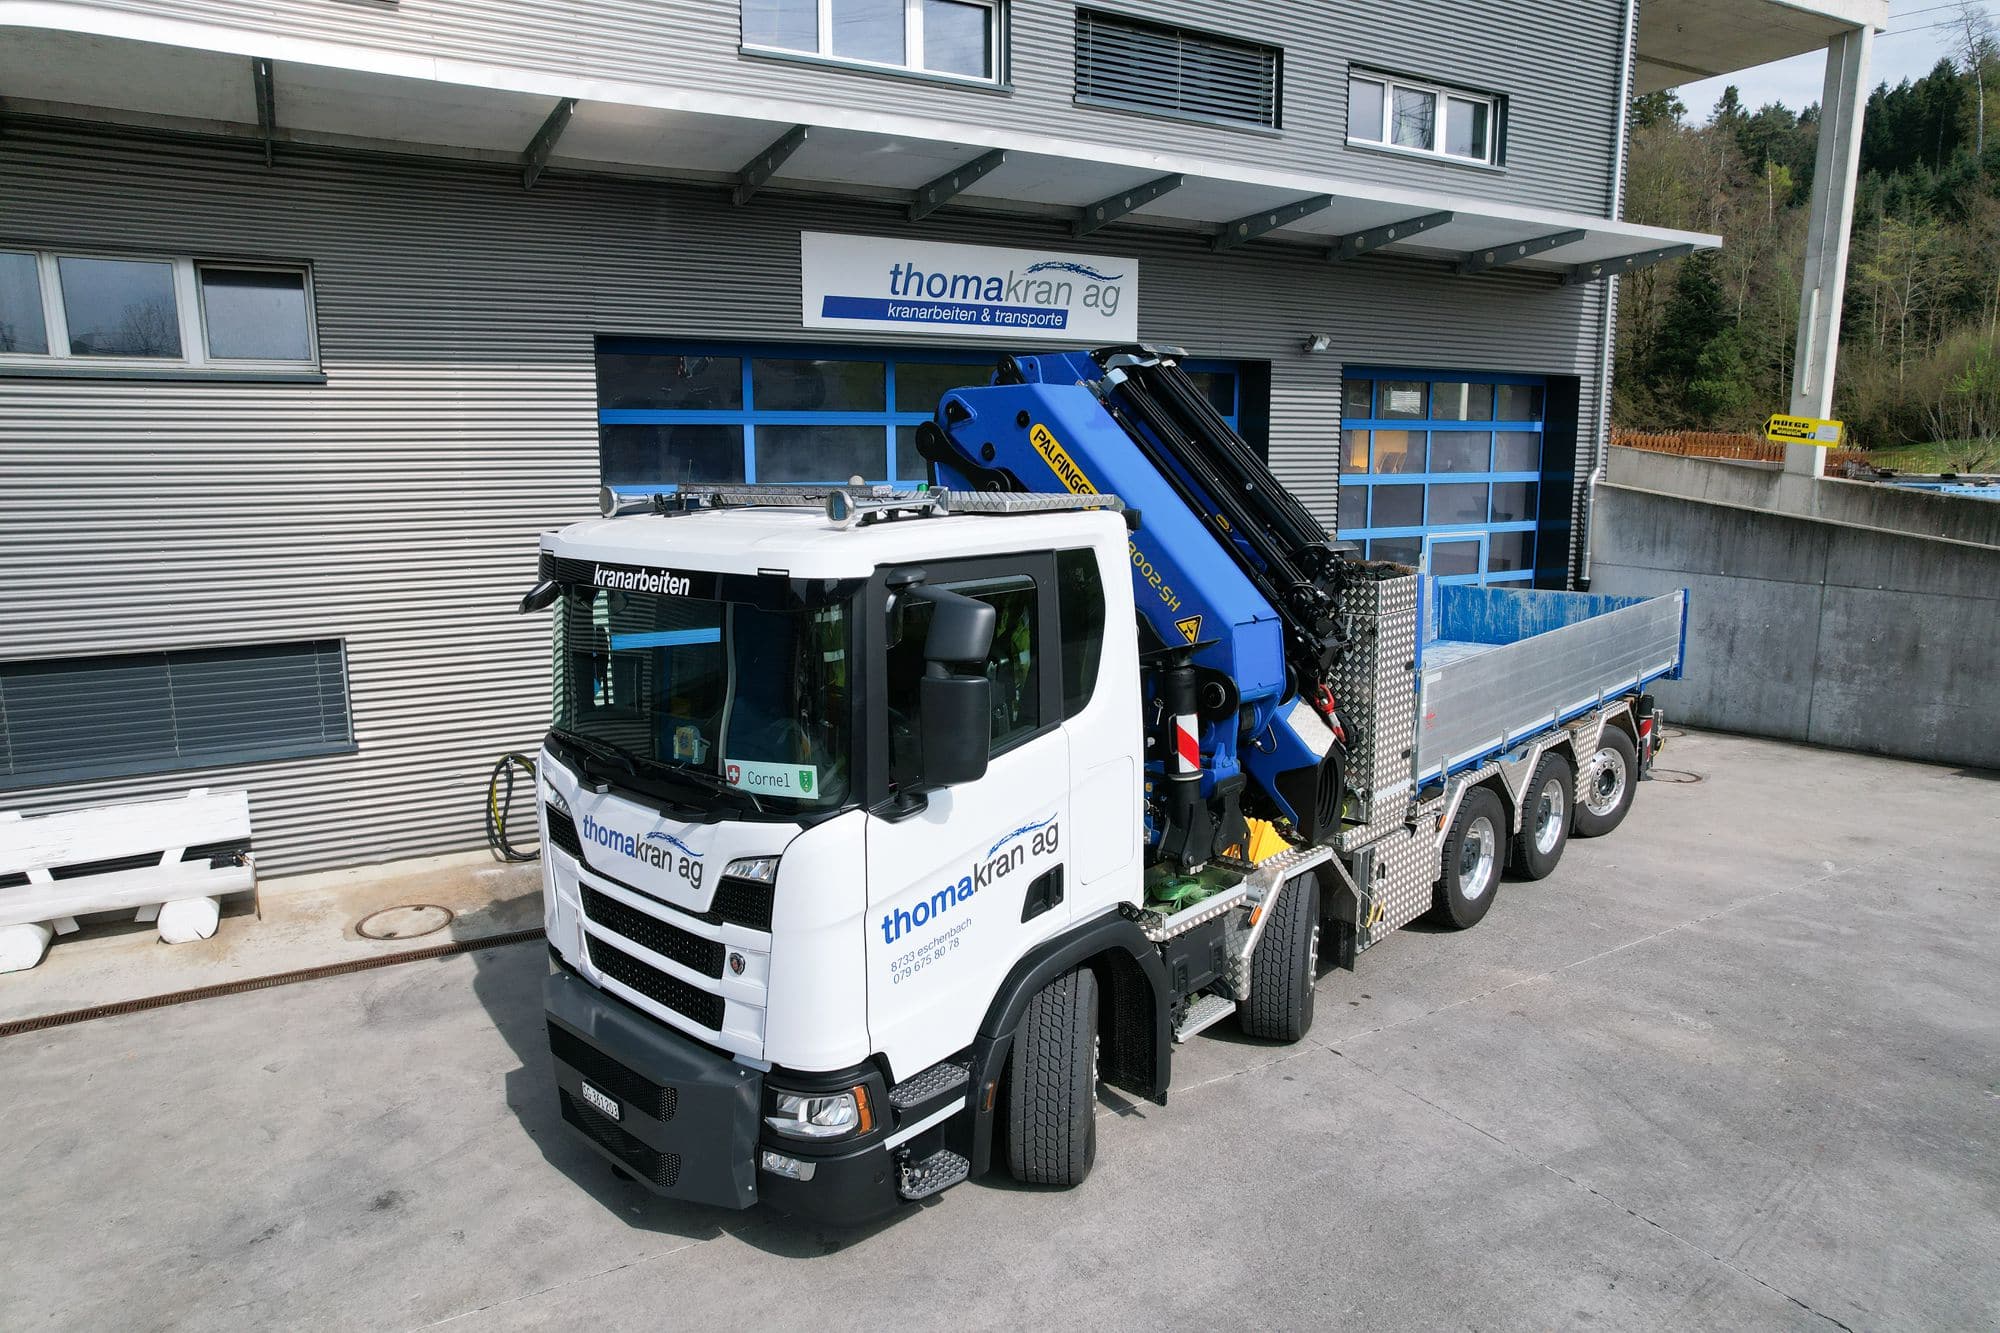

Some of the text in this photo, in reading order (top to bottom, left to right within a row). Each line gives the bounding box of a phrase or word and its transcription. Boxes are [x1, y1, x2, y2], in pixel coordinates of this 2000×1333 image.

[889, 262, 1121, 317] thomakran ag
[887, 303, 1063, 328] kranarbeiten & transporte
[593, 563, 690, 596] kranarbeiten
[747, 771, 790, 788] Cornel
[583, 814, 704, 890] thomakran ag
[881, 822, 1059, 944] thomakran ag
[890, 917, 972, 973] 8733 eschenbach
[893, 938, 960, 985] 079 675 80 78
